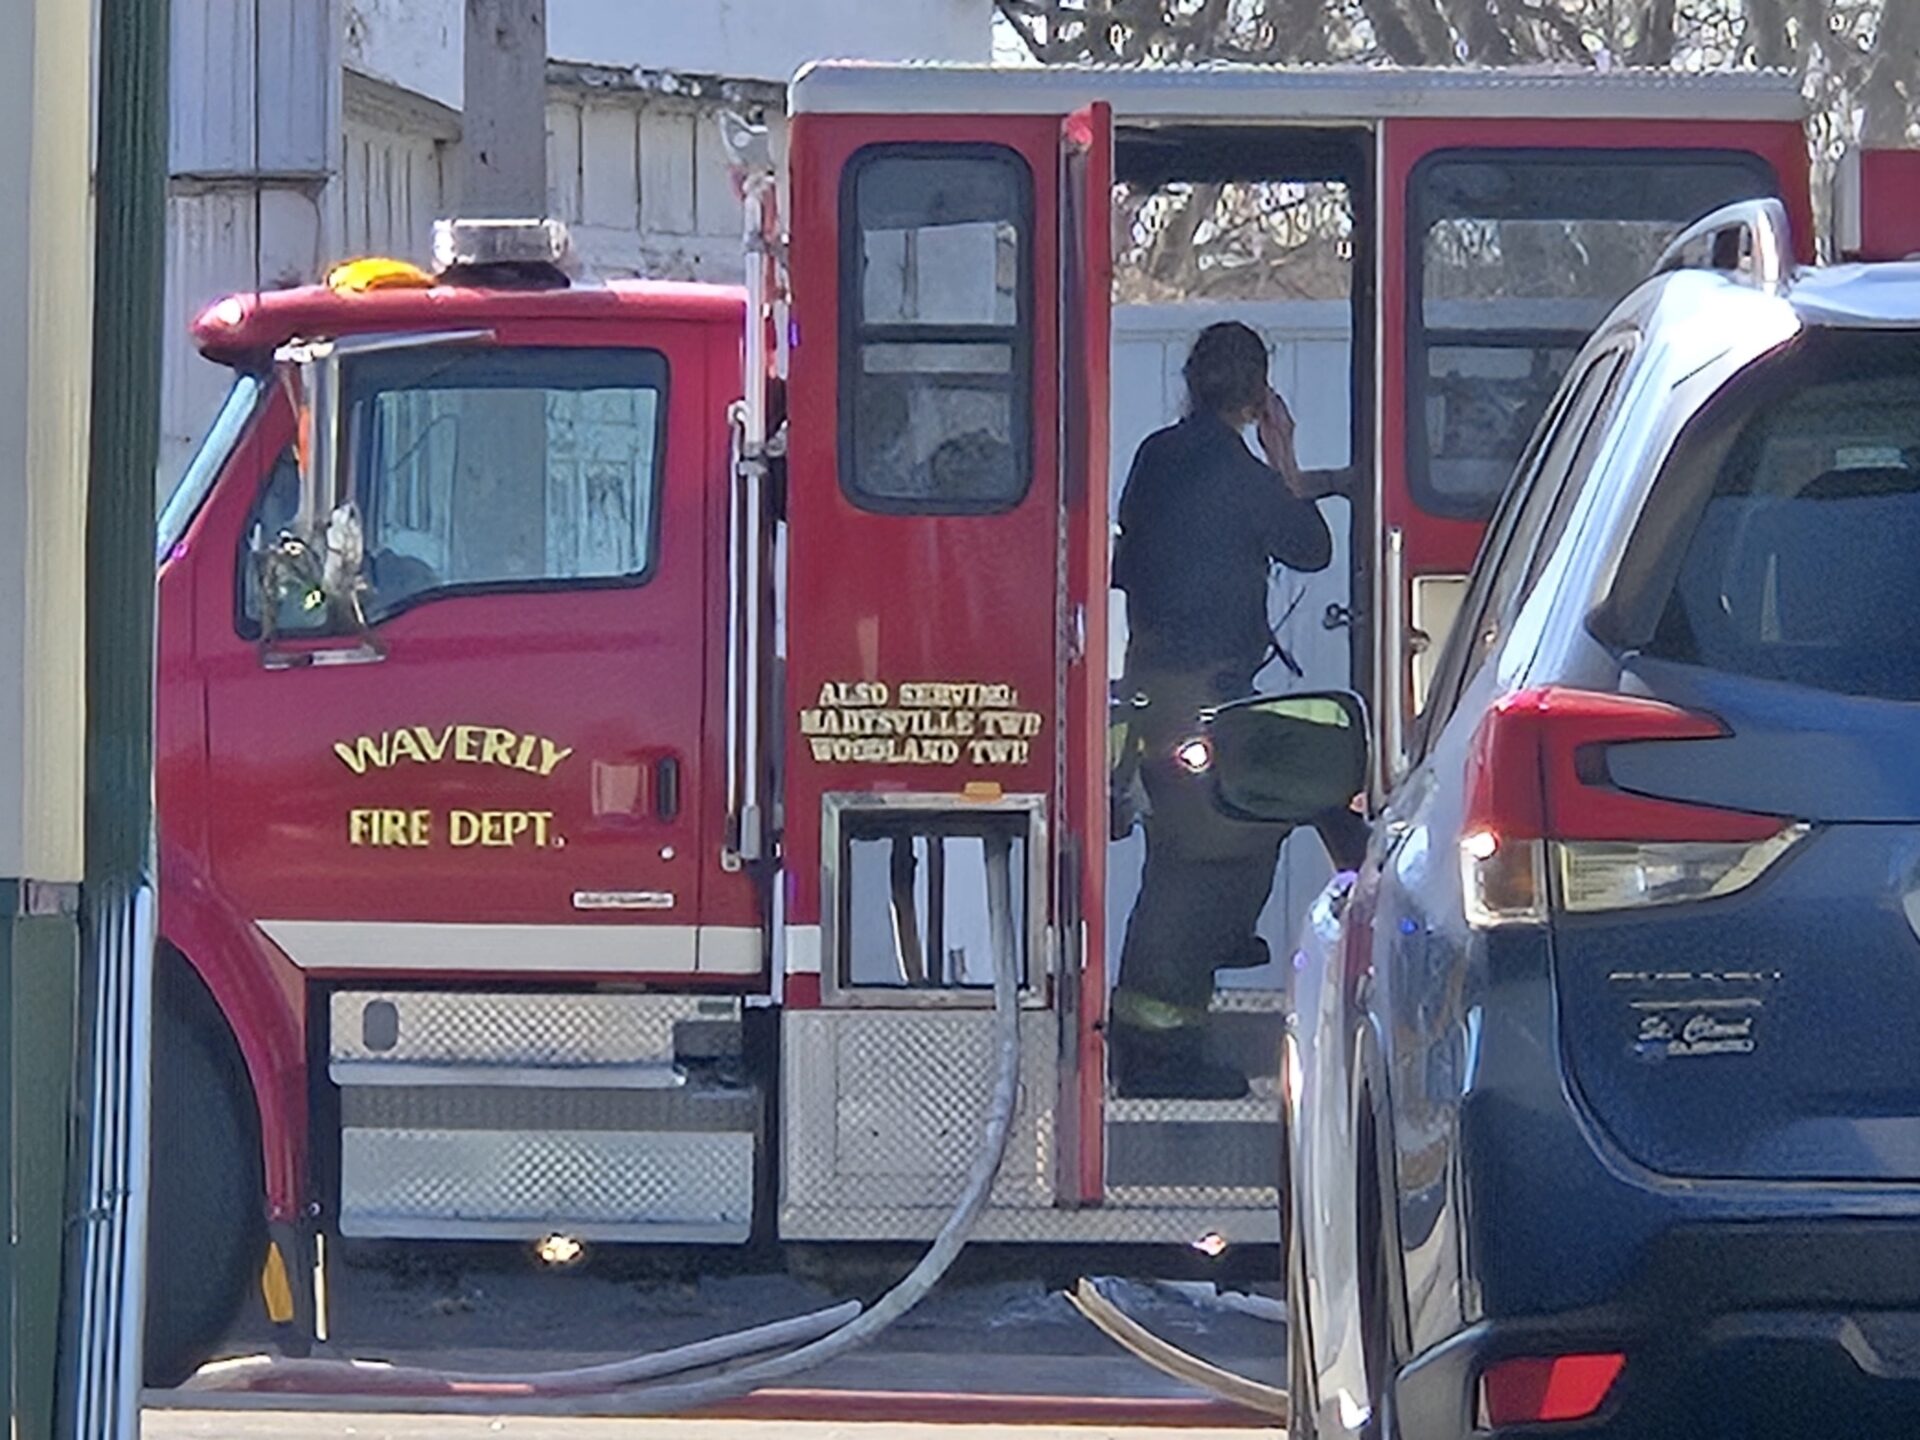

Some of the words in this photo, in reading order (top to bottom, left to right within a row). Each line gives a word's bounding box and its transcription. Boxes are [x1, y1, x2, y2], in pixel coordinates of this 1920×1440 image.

[820, 683, 888, 706] ALSO
[334, 725, 572, 775] WAVERLY
[810, 738, 958, 764] WOODLAND
[350, 810, 431, 845] FIRE
